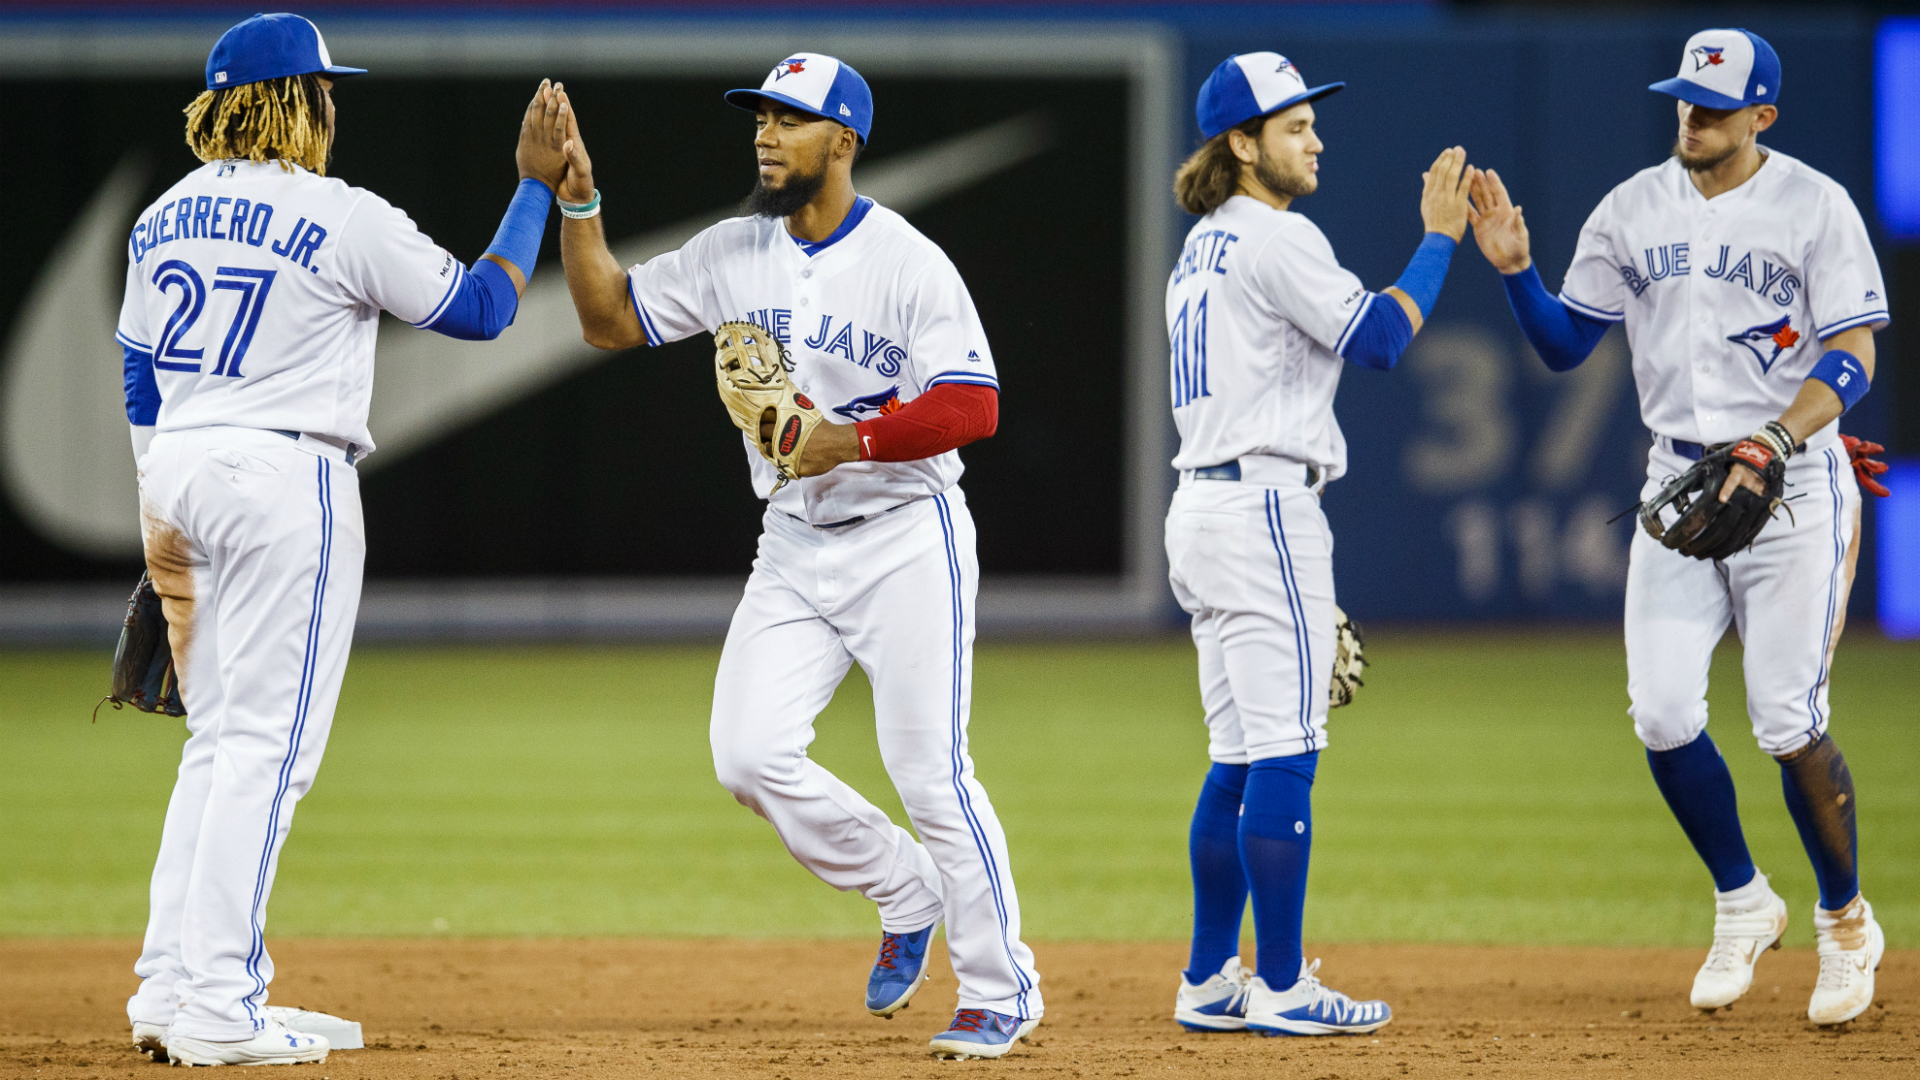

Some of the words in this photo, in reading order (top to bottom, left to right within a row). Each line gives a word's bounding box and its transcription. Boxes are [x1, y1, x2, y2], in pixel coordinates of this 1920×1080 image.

[131, 196, 274, 264] GUERRERO
[271, 217, 327, 275] JR.
[1704, 244, 1801, 306] JAYS
[151, 259, 278, 378] 27
[803, 314, 908, 378] JAYS
[1170, 288, 1213, 409] 11
[1837, 371, 1851, 387] 8
[780, 418, 800, 454] Wilson
